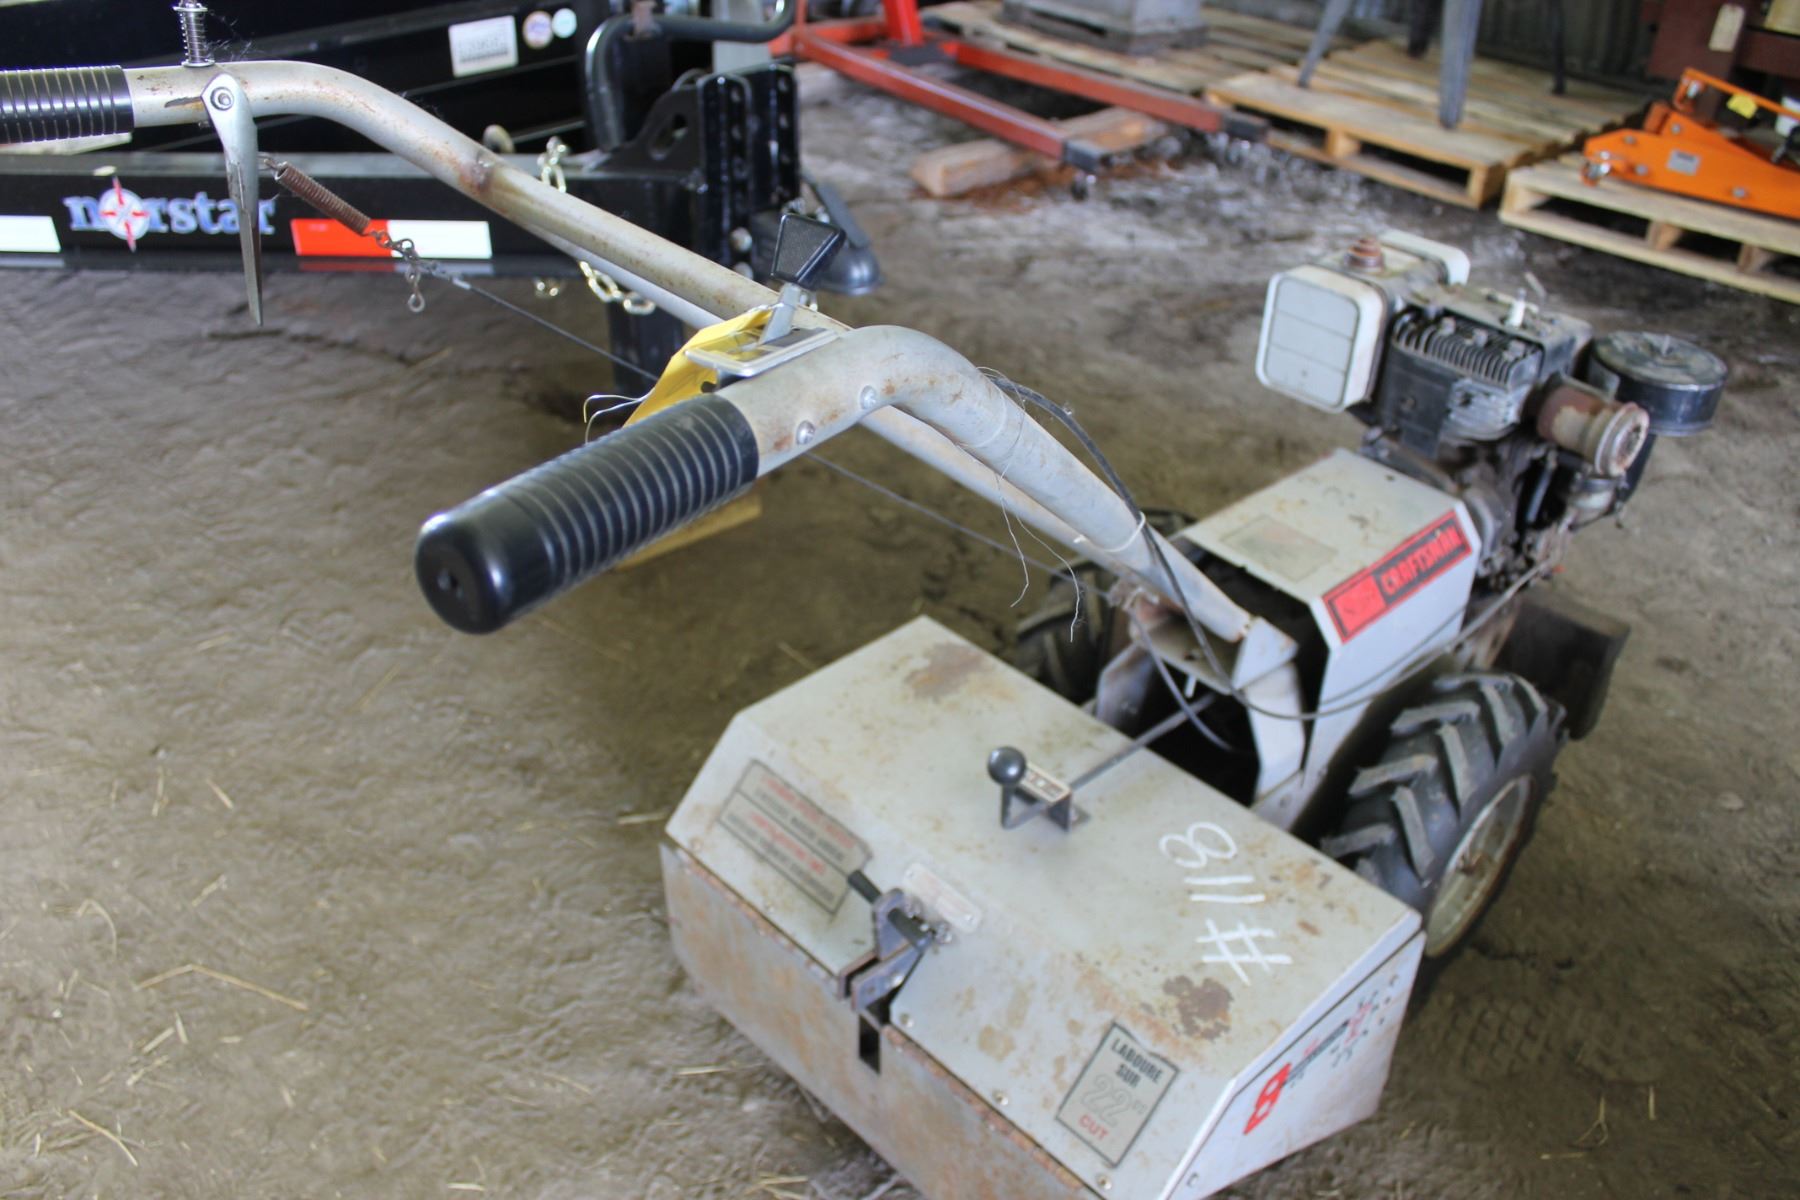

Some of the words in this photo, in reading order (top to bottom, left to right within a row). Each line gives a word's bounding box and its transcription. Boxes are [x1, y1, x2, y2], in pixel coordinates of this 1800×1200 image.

[62, 184, 275, 242] norstar
[1380, 525, 1462, 595] CRAFTSMAN
[1078, 1114, 1109, 1140] CUT
